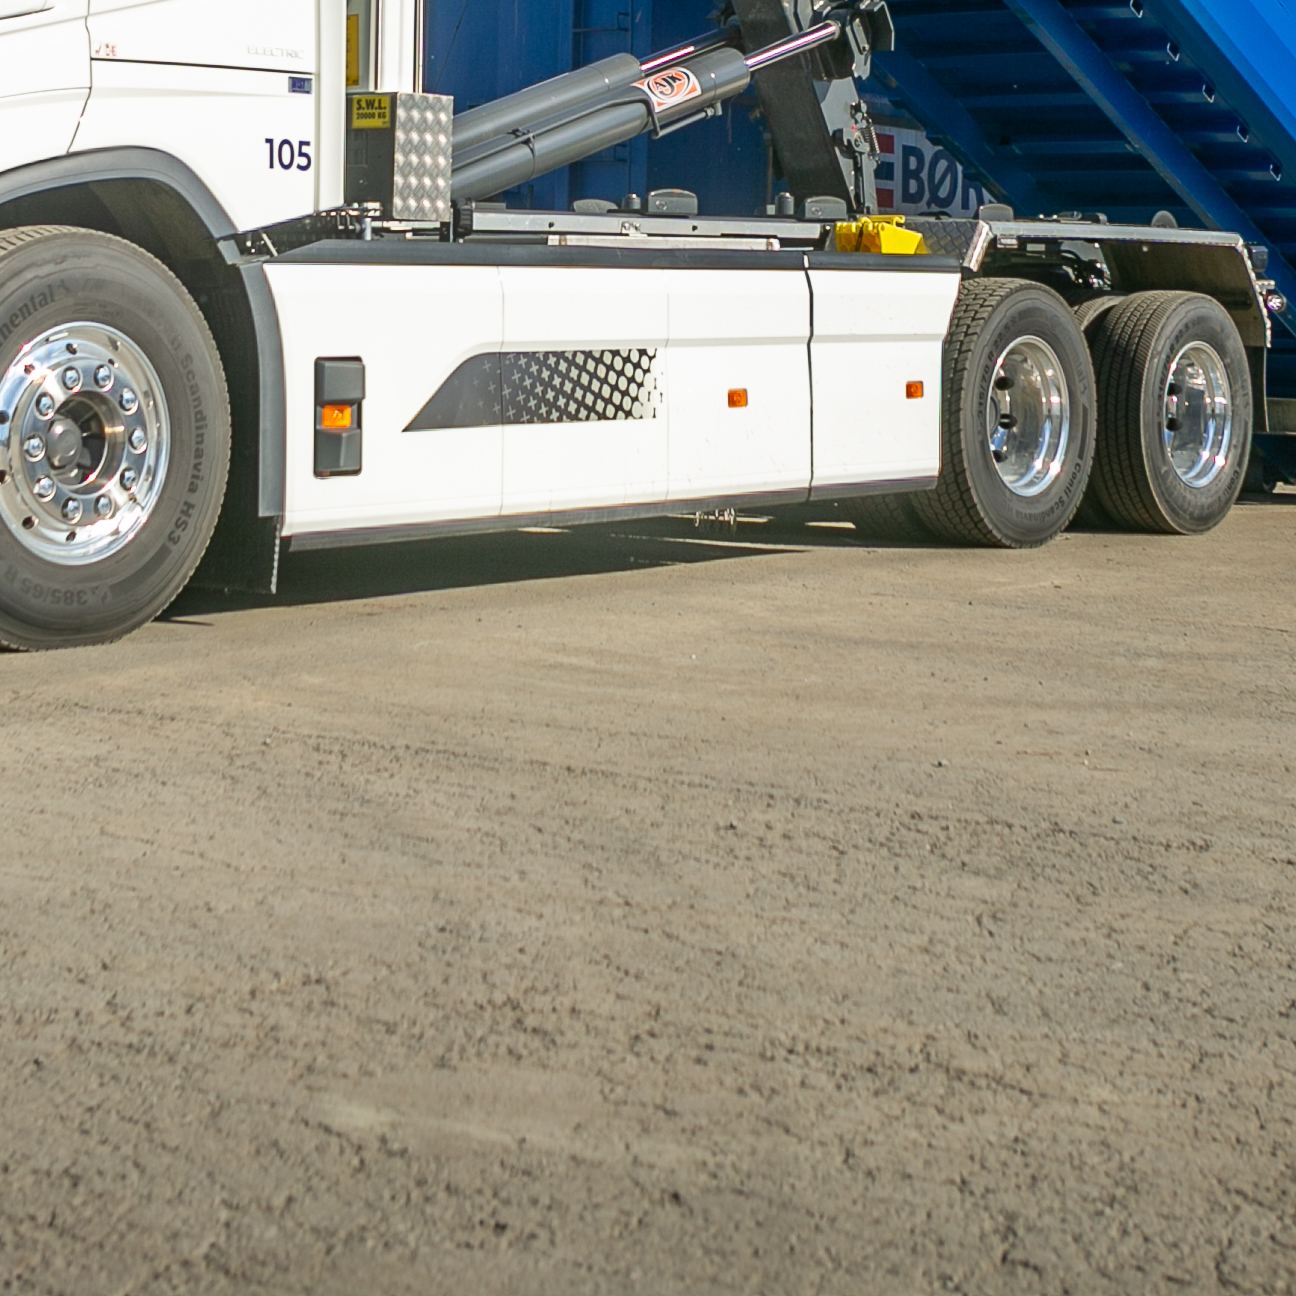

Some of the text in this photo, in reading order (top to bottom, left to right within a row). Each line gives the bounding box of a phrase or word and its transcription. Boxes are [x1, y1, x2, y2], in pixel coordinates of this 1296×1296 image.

[247, 45, 305, 60] ELECTRIC
[654, 74, 682, 96] AJK
[356, 98, 388, 111] S.W.L.
[356, 112, 387, 120] 20000 KG
[265, 138, 312, 171] 105
[178, 352, 209, 492] Scandinavia
[1063, 461, 1083, 500] Conti
[166, 504, 197, 547] HS3
[20, 576, 89, 606] 385/65
